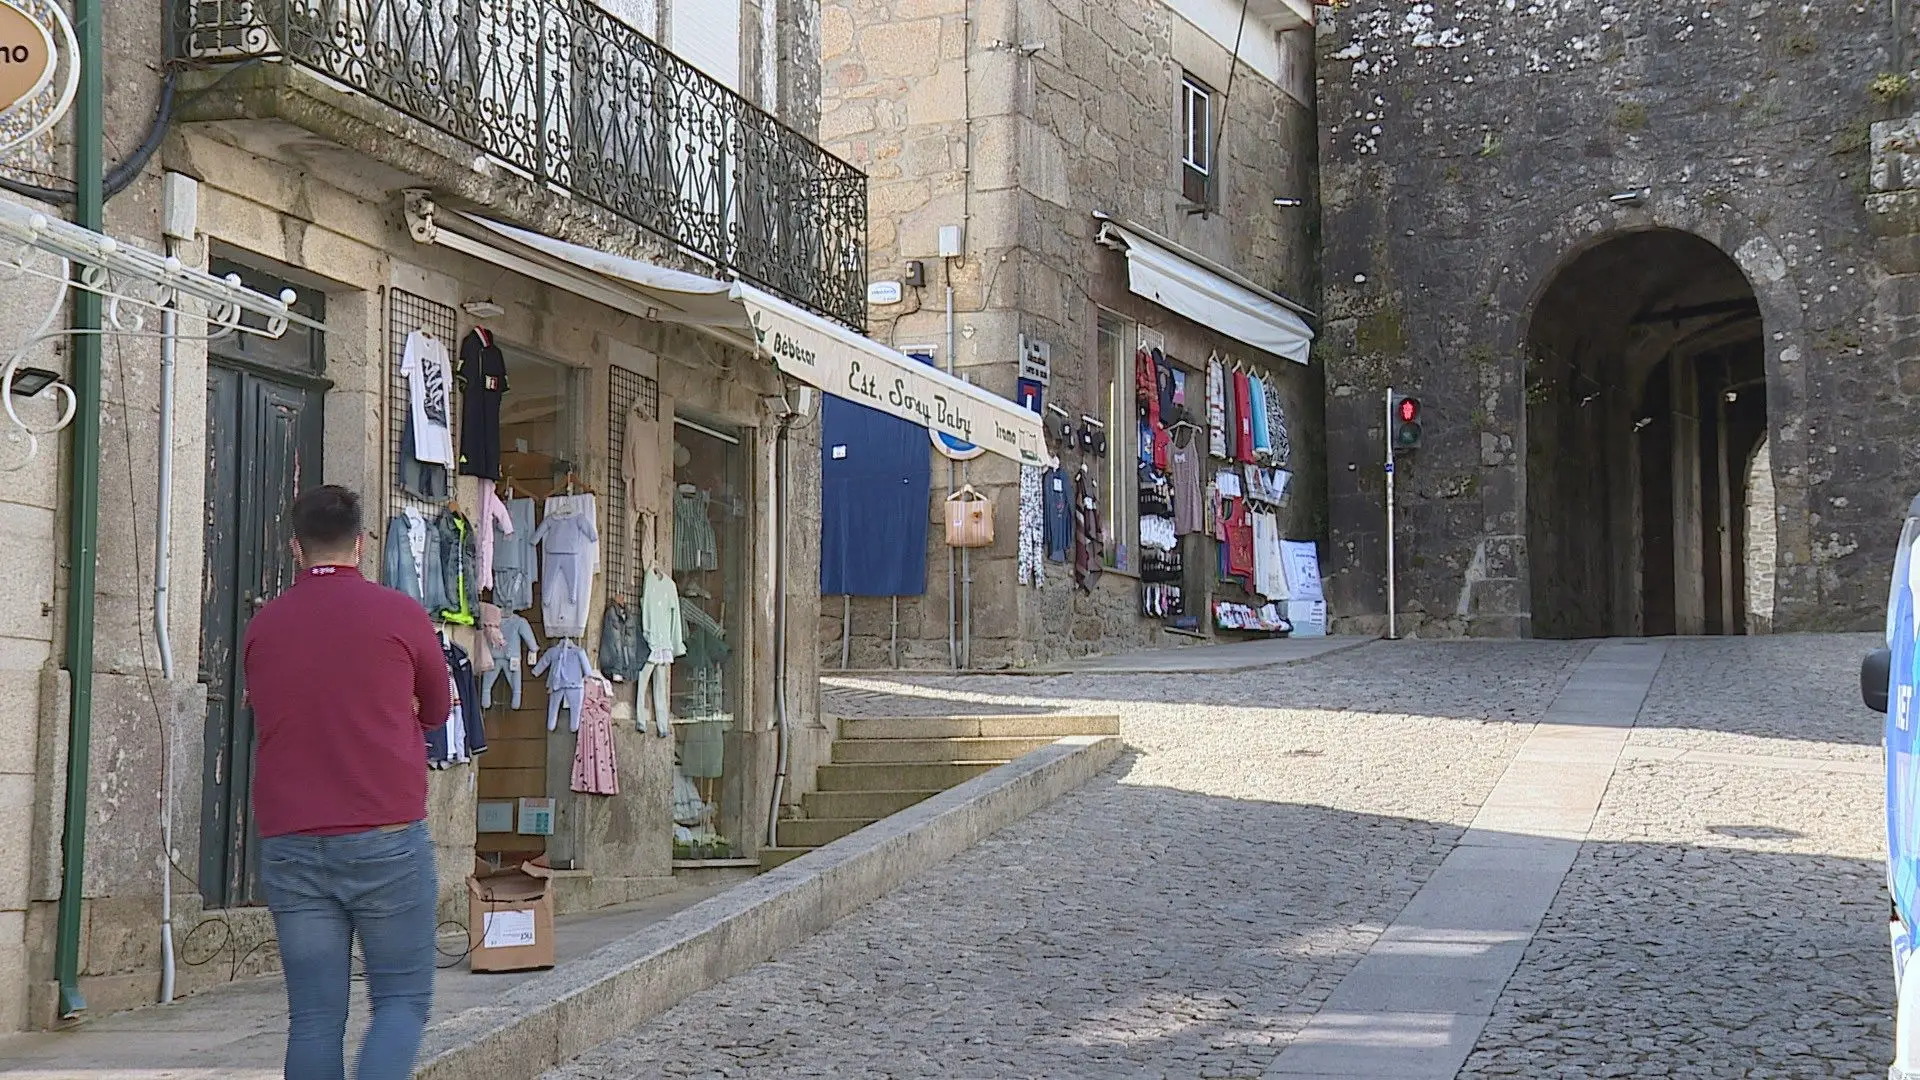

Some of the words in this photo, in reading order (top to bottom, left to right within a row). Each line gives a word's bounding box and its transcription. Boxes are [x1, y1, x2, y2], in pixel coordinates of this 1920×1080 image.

[773, 332, 816, 367] Bébécar
[848, 360, 883, 401] Est.
[933, 394, 972, 441] Baby
